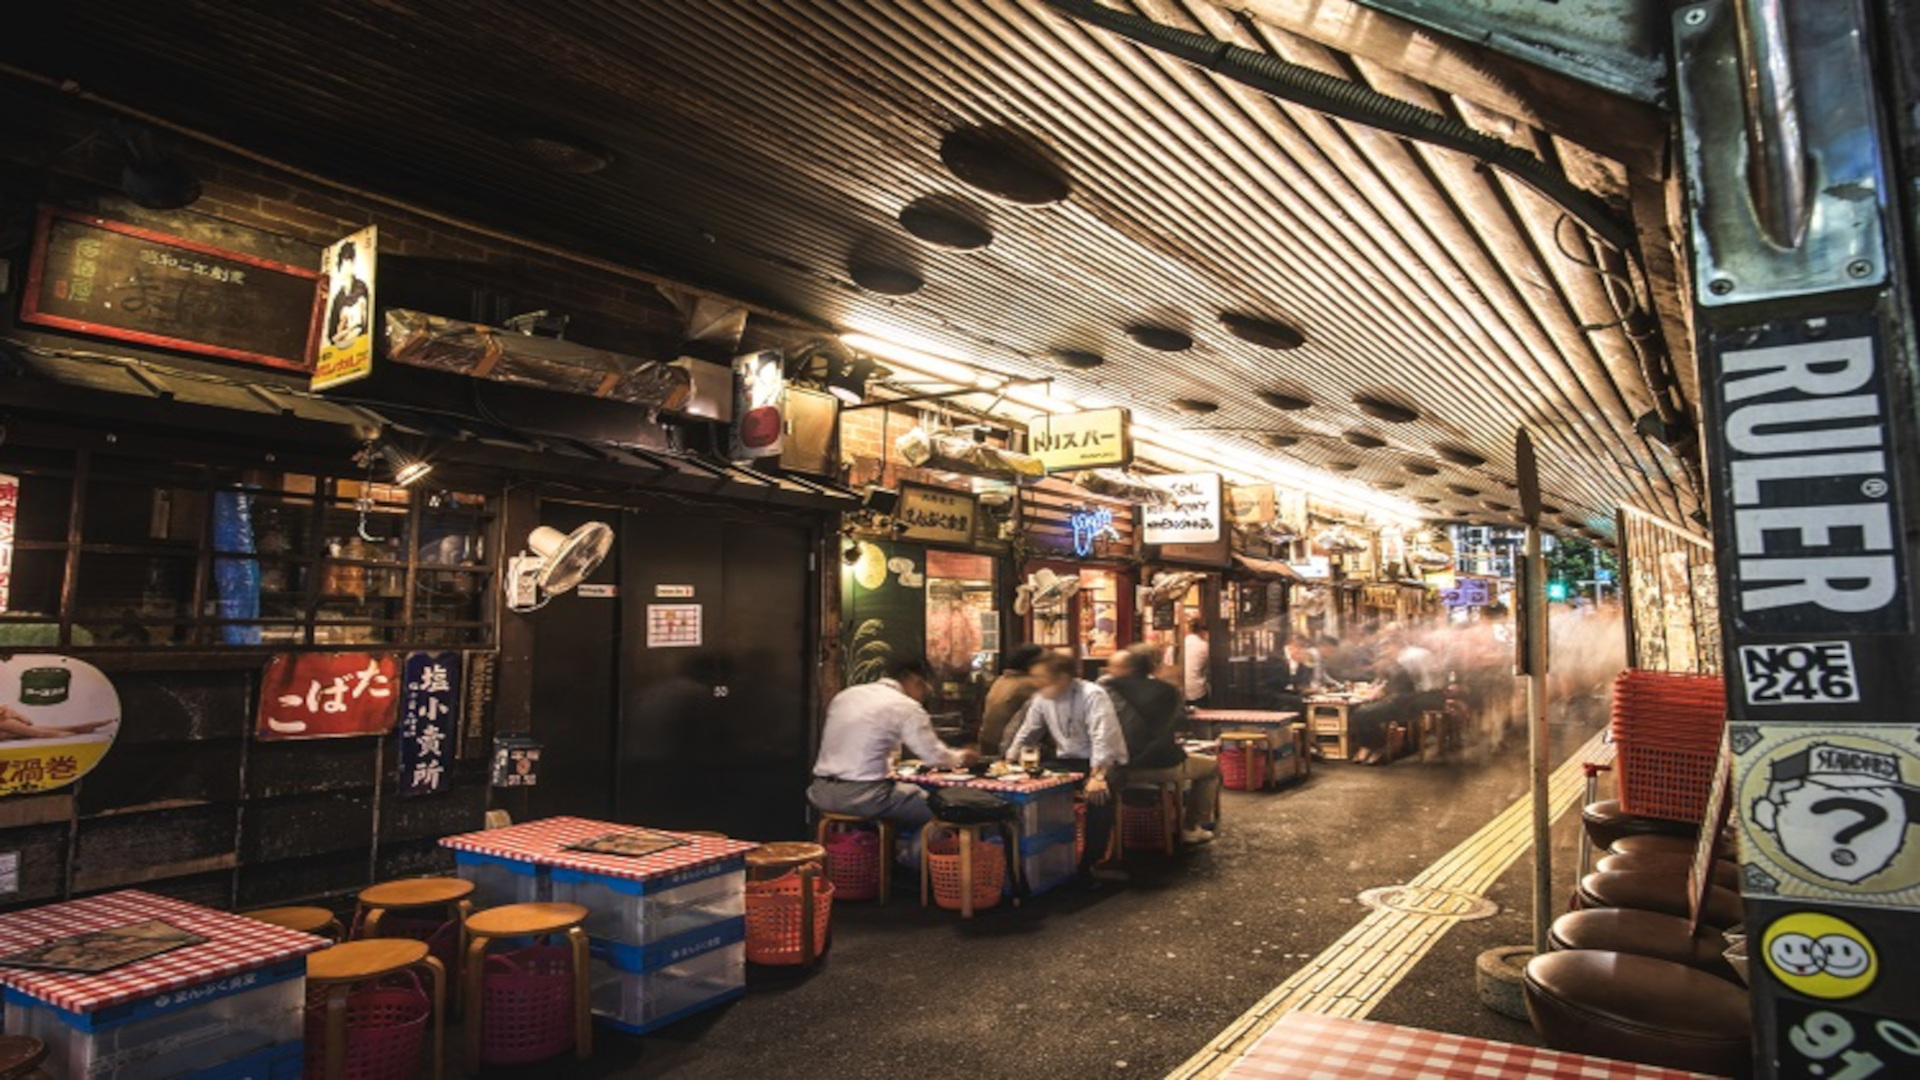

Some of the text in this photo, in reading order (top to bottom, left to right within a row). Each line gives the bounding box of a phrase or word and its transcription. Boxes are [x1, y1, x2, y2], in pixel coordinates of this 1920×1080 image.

[1720, 336, 1898, 613] RULER
[1743, 643, 1850, 677] NOE
[1748, 671, 1853, 701] 246
[267, 658, 391, 734] たばこ
